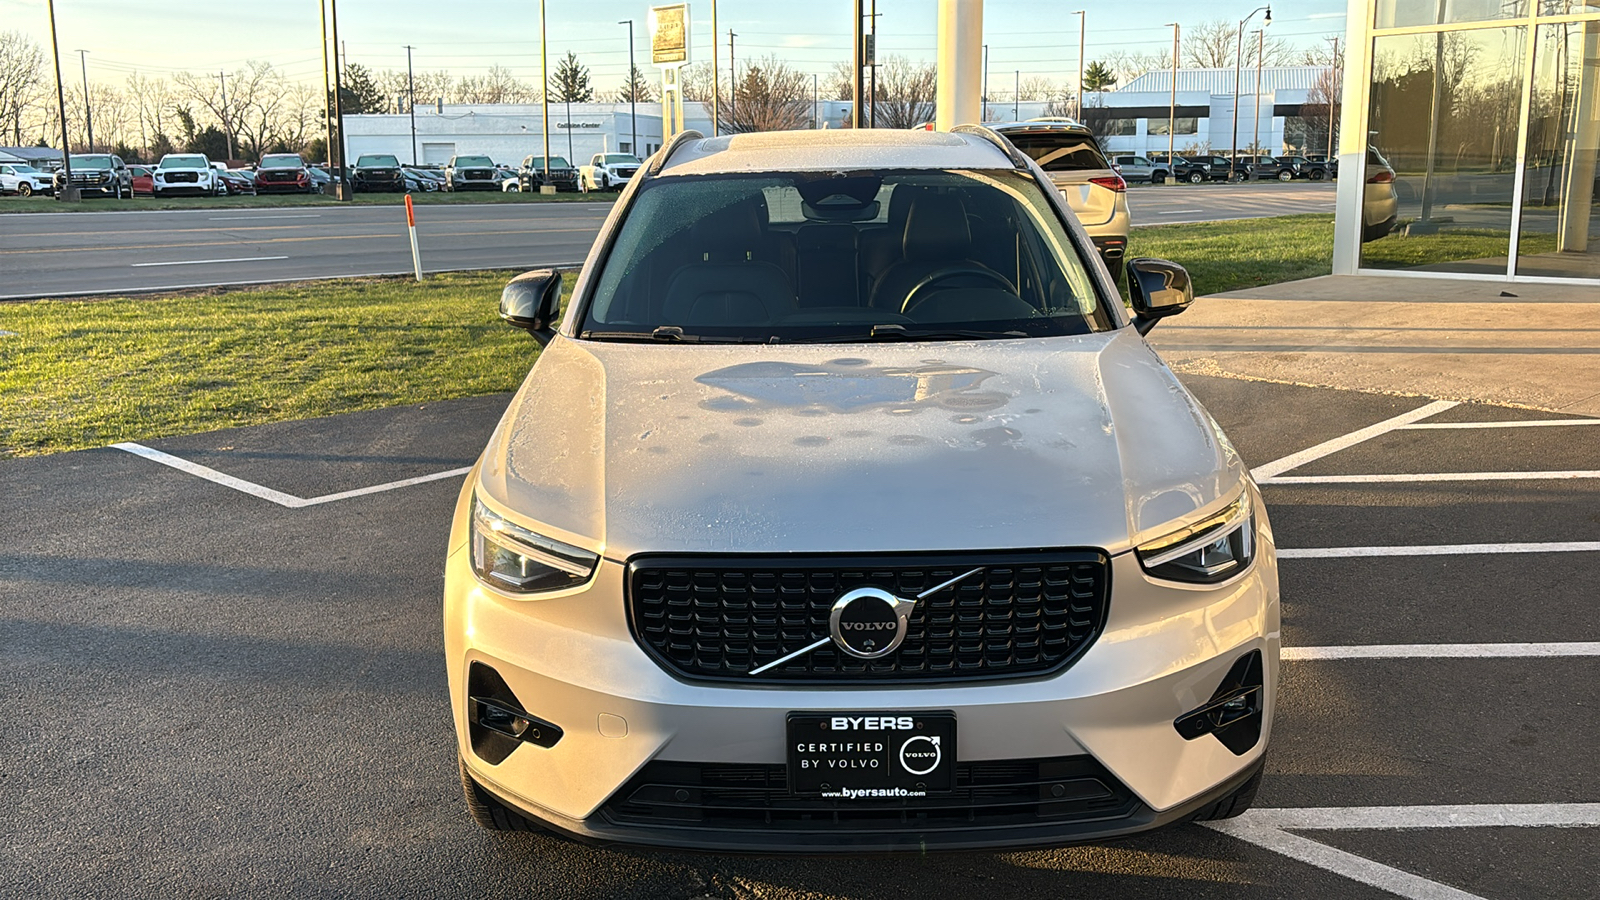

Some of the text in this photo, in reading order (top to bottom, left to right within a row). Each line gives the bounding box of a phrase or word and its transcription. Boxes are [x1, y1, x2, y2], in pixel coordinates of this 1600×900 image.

[841, 621, 896, 631] VOLVO
[831, 717, 914, 730] BYERS
[797, 743, 883, 752] CERTIFIED
[801, 759, 879, 768] BY VOLVO
[821, 787, 926, 799] www.byersauto.com
